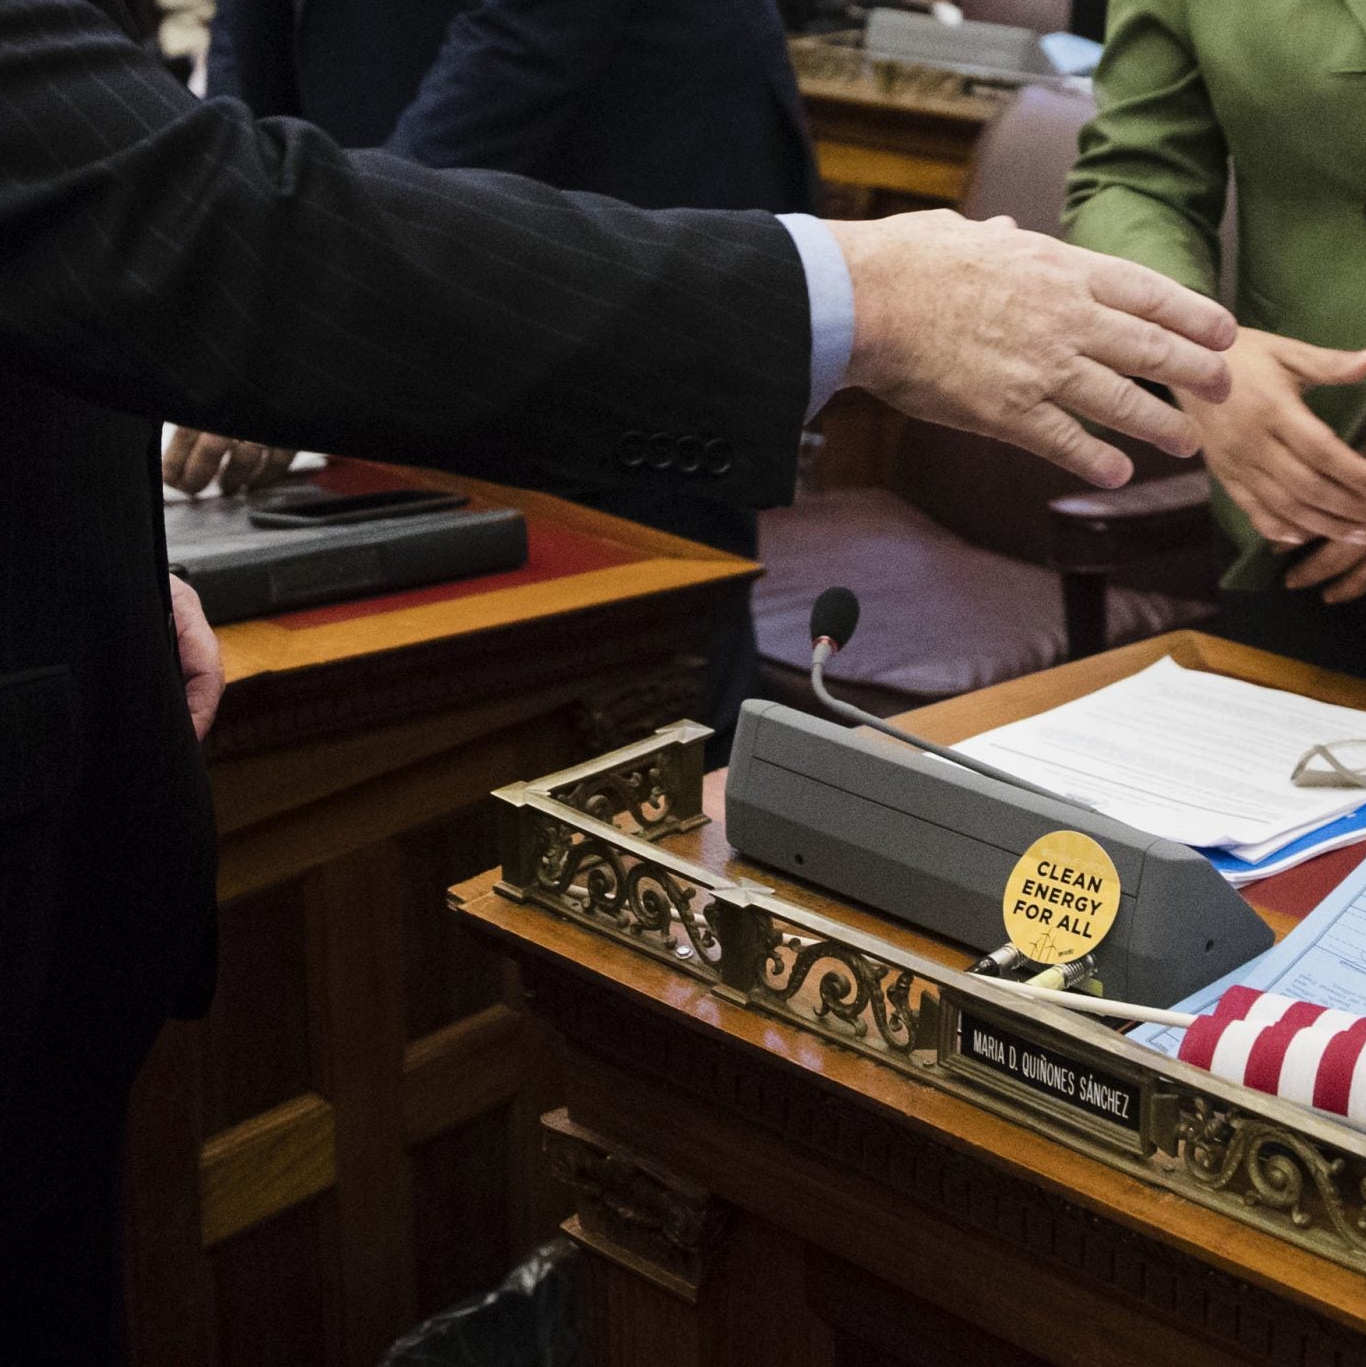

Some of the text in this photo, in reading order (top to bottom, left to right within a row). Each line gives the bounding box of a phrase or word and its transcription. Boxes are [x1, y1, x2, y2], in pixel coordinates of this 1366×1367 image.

[1037, 861, 1103, 893] CLEAN
[1022, 879, 1103, 916] ENERGY
[1013, 900, 1092, 938] FOR ALL
[973, 1029, 1130, 1119] MARIA D. QUIÑONES SÁNCHEZ
